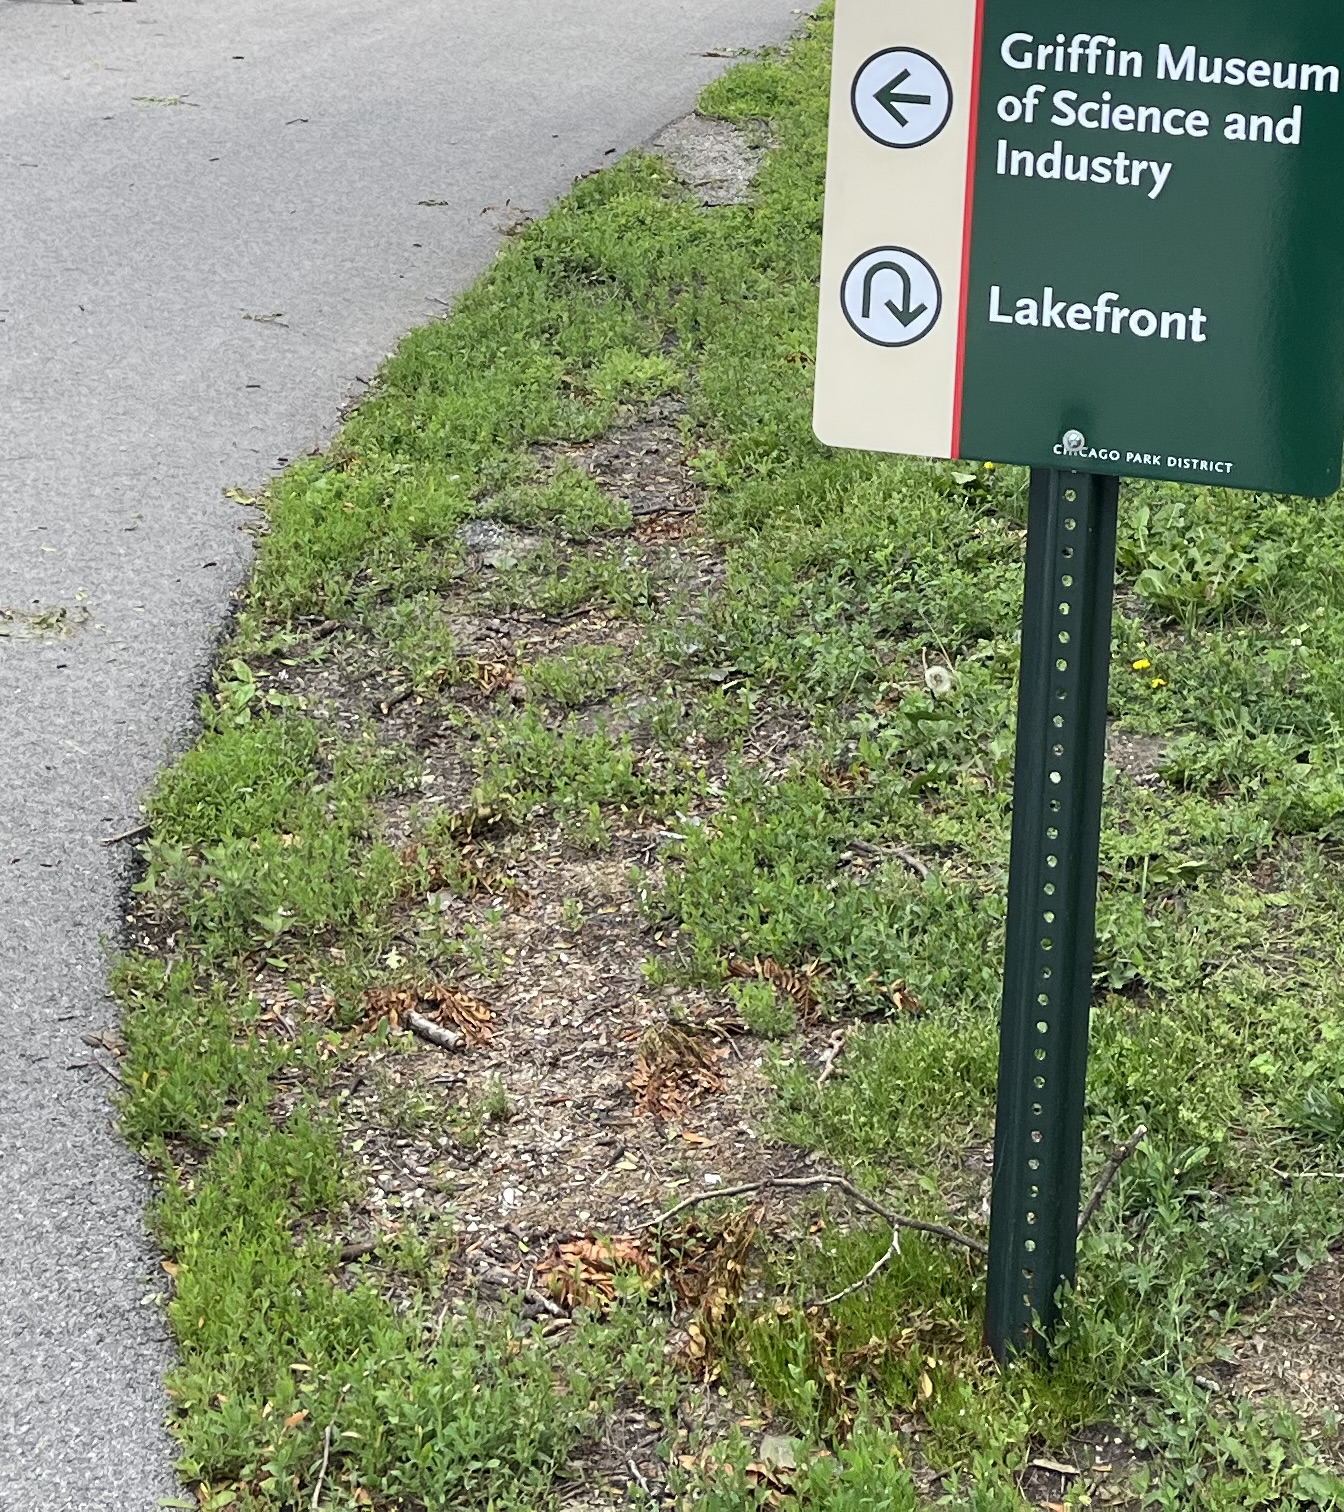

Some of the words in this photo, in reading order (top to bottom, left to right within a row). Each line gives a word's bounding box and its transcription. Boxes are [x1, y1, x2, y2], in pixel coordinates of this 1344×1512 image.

[1000, 32, 1143, 78] Griffin
[1156, 43, 1340, 93] Museum
[996, 84, 1047, 124] of
[1050, 89, 1210, 138] Science
[1223, 104, 1303, 145] and
[995, 138, 1173, 200] Industry
[988, 285, 1208, 343] Lakefront
[1125, 451, 1161, 466] PARK
[1167, 455, 1234, 474] DISTRICT
